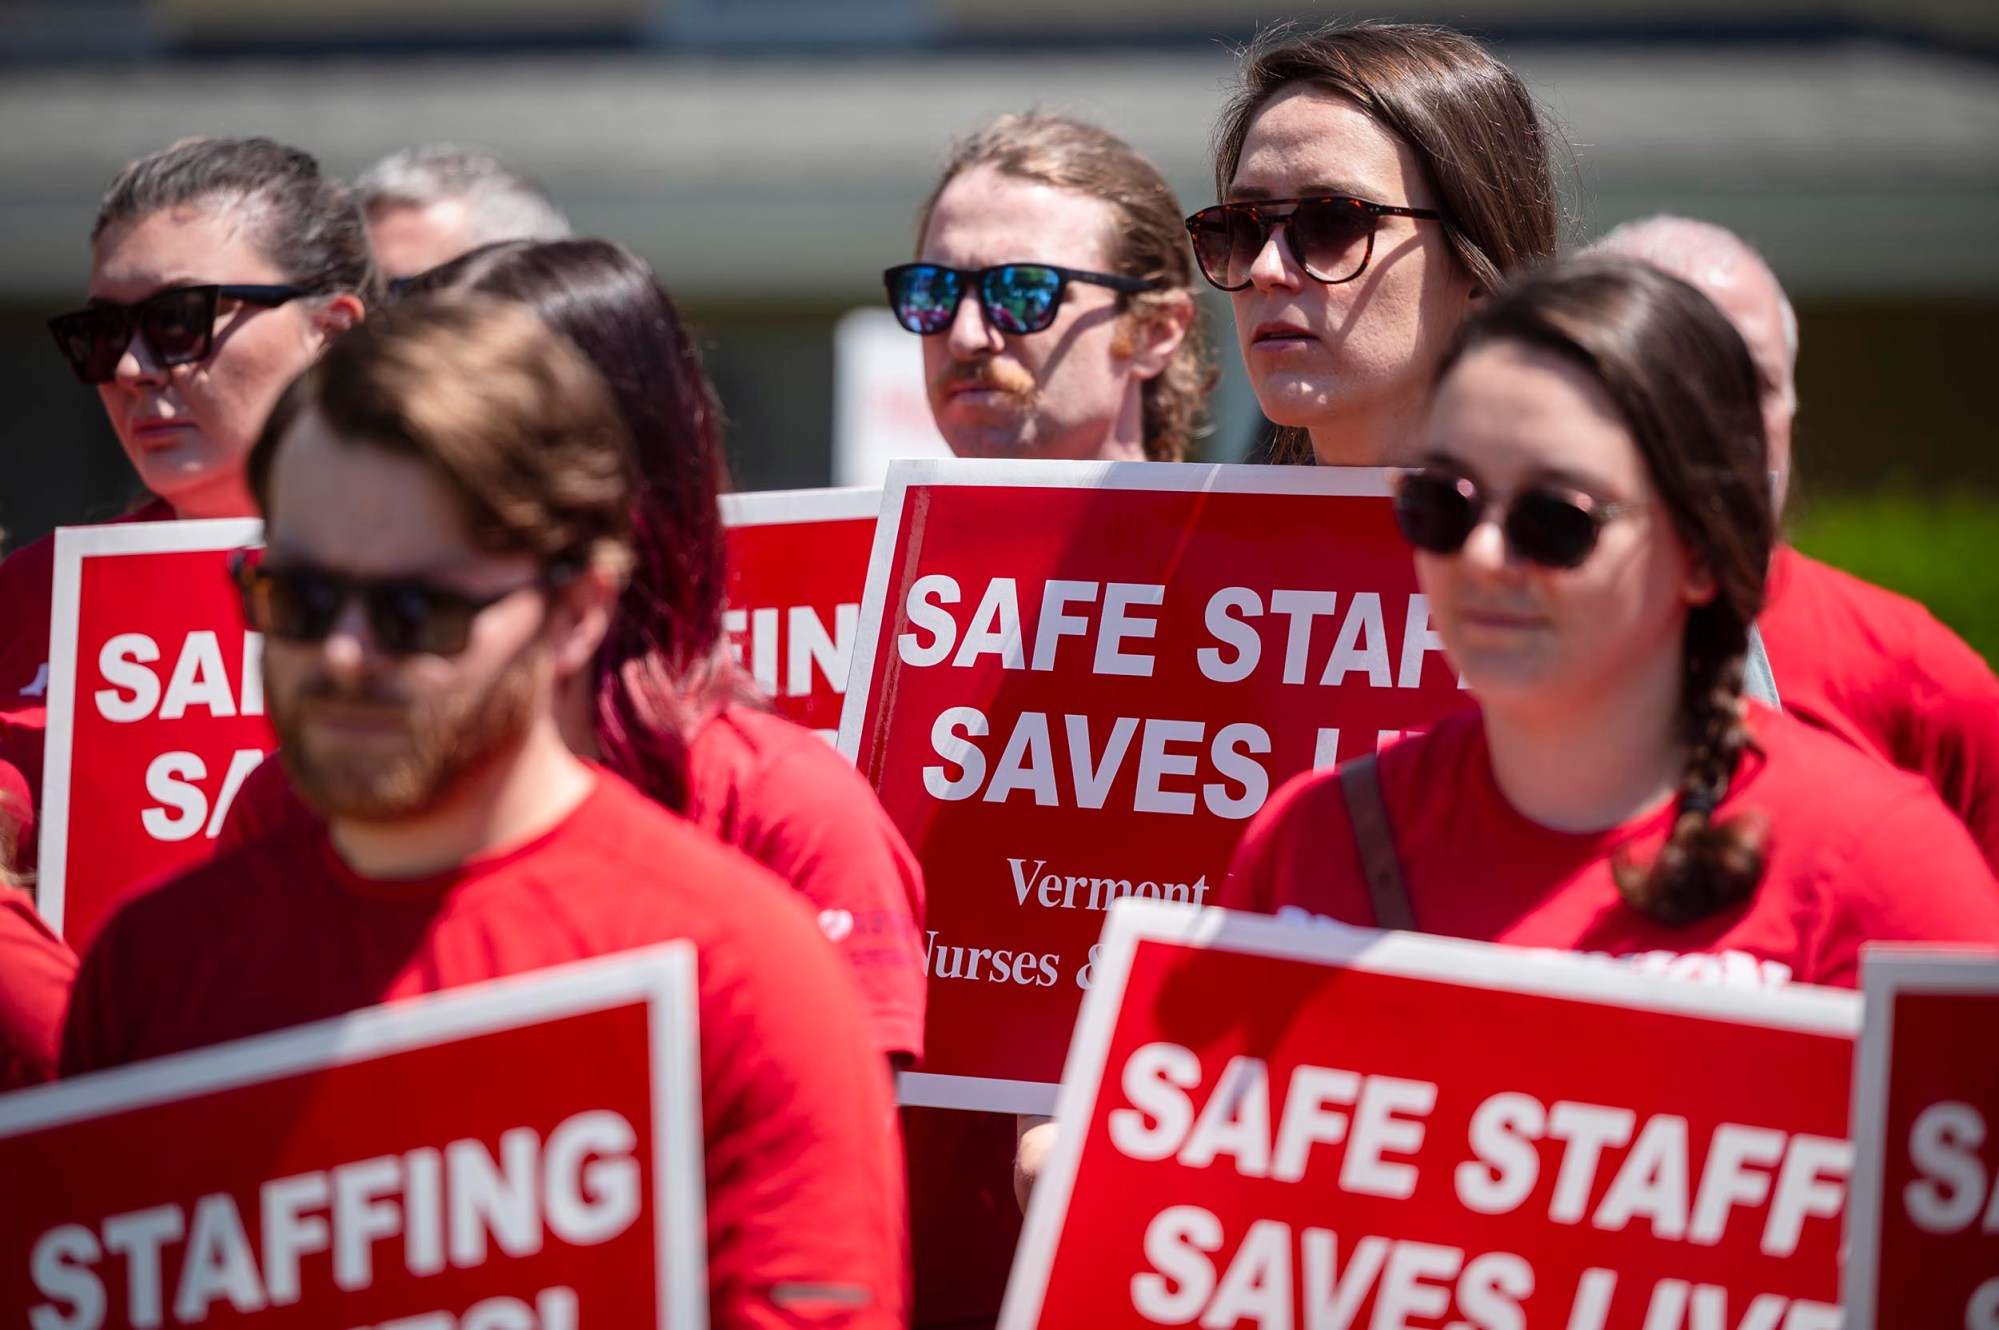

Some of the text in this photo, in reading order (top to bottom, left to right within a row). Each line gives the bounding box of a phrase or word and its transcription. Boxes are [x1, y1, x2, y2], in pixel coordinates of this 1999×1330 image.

[898, 574, 1473, 690] SAFE STAF
[923, 706, 1272, 820] SAVES
[1108, 1042, 1438, 1199] SAFE
[28, 1109, 642, 1330] STAFFING
